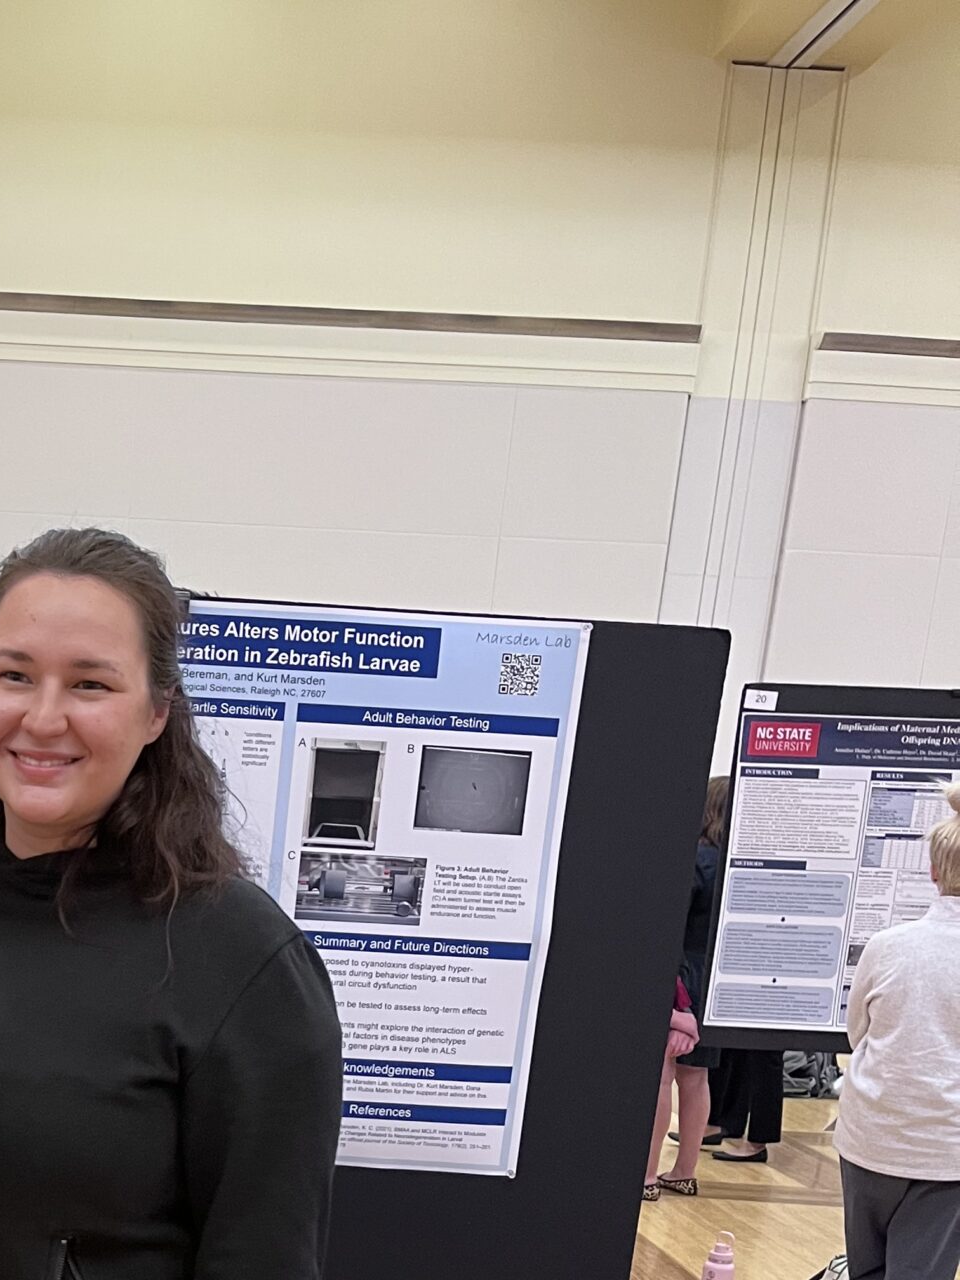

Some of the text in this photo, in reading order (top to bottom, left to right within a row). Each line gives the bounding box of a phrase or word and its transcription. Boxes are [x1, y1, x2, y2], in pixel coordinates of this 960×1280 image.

[177, 622, 424, 648] ures Alters Motor Function
[476, 632, 572, 648] Marsden Lab
[176, 644, 420, 672] eration in Zebrafish Larvae
[234, 672, 254, 682] and
[256, 672, 278, 683] Kurt
[280, 674, 326, 686] Marsden
[183, 683, 326, 698] ogical Sciences, Raleigh NC, 27607
[756, 695, 767, 704] 20
[189, 702, 278, 719] artle Sensitivity
[362, 710, 490, 732] Adult Behavior Testing
[837, 722, 888, 732] Implications
[890, 724, 900, 732] of
[901, 724, 940, 734] Maternal
[756, 727, 812, 741] NC STATE
[901, 735, 940, 746] Offspring
[298, 738, 307, 748] A
[408, 744, 415, 754] B
[755, 740, 811, 752] UNIVERSITY
[876, 772, 904, 780] RESULTS
[288, 850, 296, 860] C
[314, 935, 489, 956] Summary and Future Directions
[361, 960, 406, 970] cyanotoxins
[409, 962, 446, 972] displayed
[448, 965, 474, 974] hyper-
[348, 970, 373, 979] during
[376, 971, 408, 980] behavior
[448, 976, 470, 984] result
[348, 980, 417, 990] circuit dysfunction
[359, 1002, 382, 1010] tested
[384, 1002, 392, 1010] to
[394, 1004, 421, 1012] assess
[423, 1005, 460, 1014] long-term
[357, 1023, 378, 1031] might
[380, 1024, 408, 1032] explore
[426, 1026, 465, 1034] interaction
[476, 1029, 504, 1037] genetic
[353, 1032, 378, 1040] factors
[390, 1034, 420, 1042] disease
[422, 1037, 466, 1046] phenotypes
[370, 1044, 390, 1052] plays
[399, 1045, 412, 1054] key
[344, 1062, 435, 1076] knowledgements
[349, 1104, 412, 1118] References
